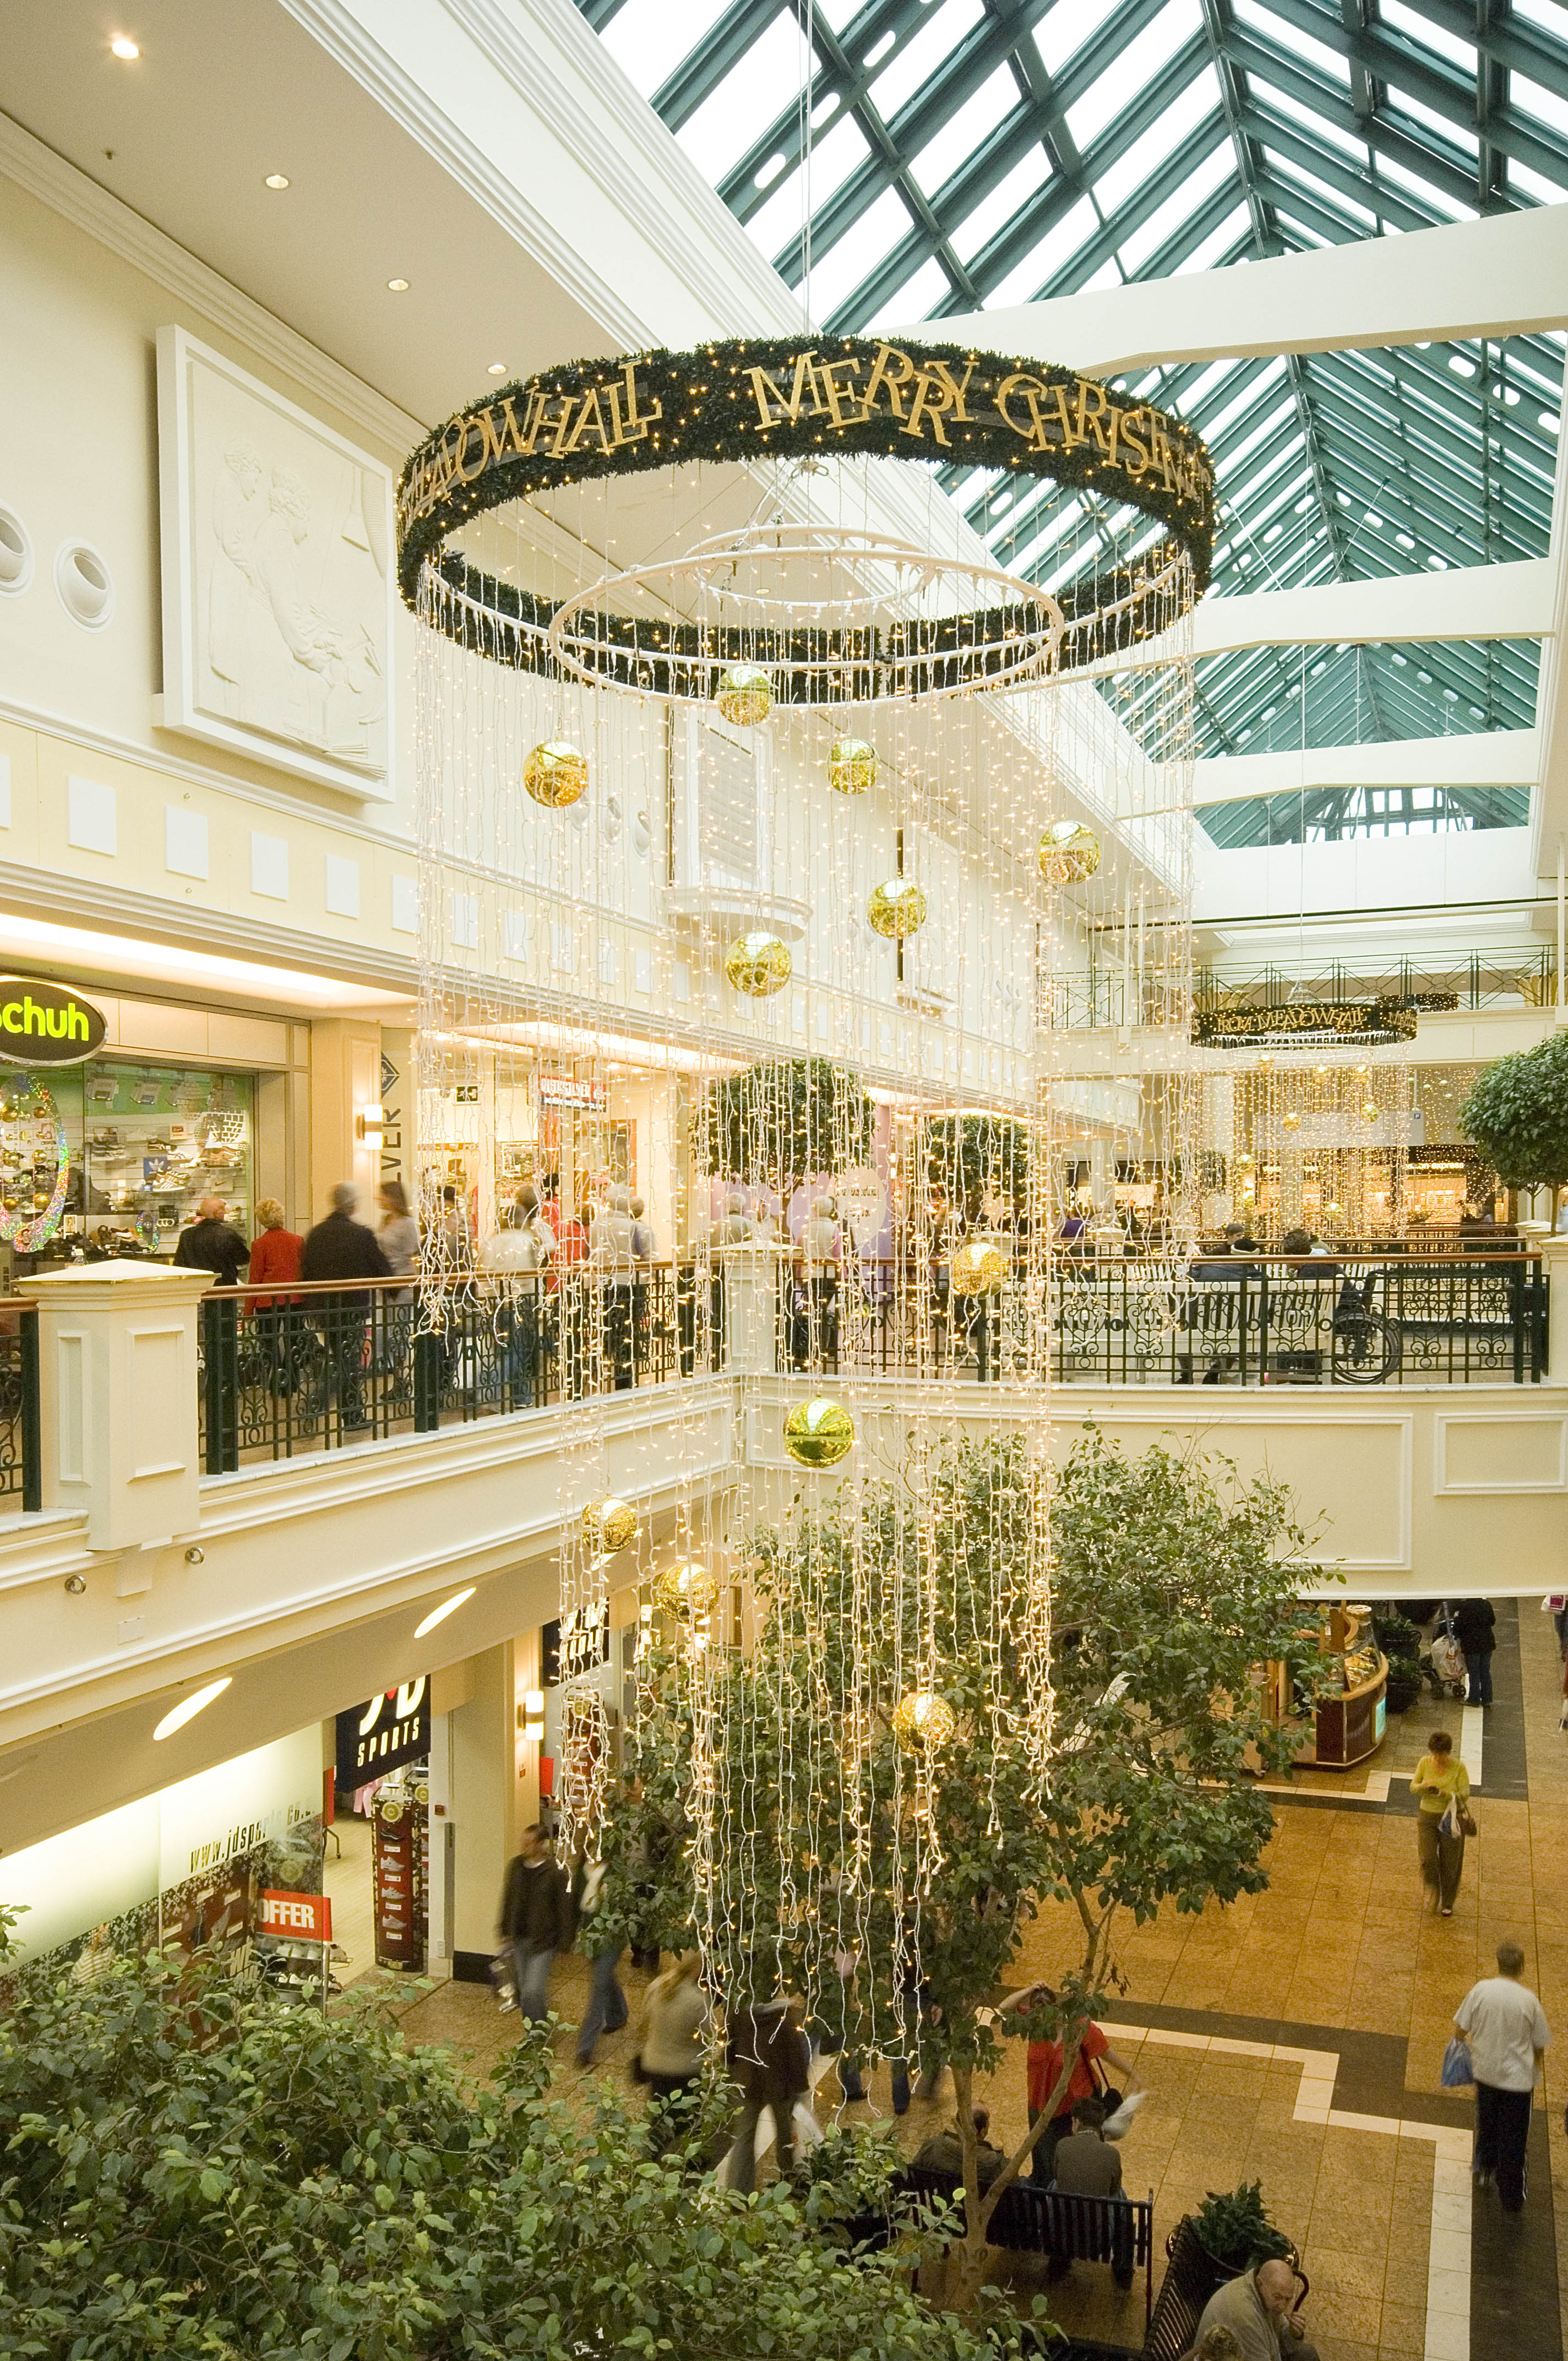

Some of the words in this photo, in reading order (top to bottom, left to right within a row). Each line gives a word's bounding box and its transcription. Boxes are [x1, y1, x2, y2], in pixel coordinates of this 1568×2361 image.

[742, 342, 979, 447] MERRY
[0, 996, 89, 1041] chuh
[1256, 1007, 1368, 1030] MEADOWHALL
[357, 1717, 420, 1767] SPORTS
[259, 1898, 315, 1929] OFFER
